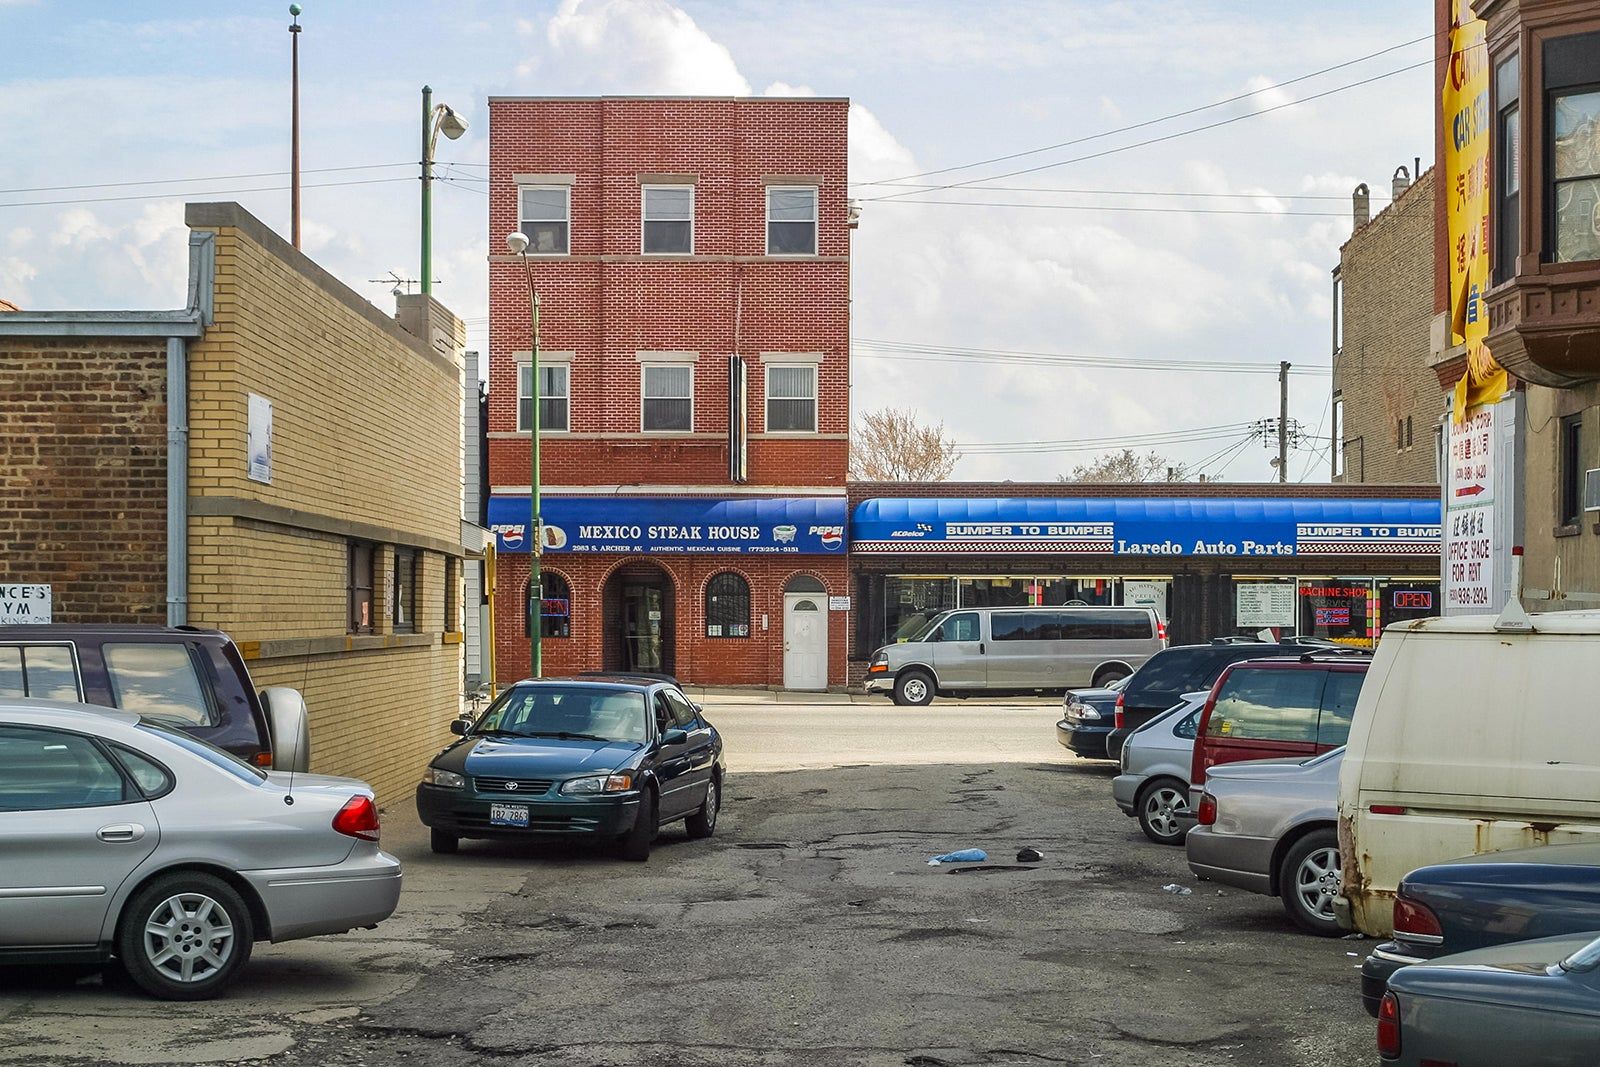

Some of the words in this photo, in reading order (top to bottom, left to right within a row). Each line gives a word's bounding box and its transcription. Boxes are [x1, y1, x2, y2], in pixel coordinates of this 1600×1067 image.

[1453, 106, 1470, 152] CAR
[490, 524, 525, 534] PEPSI
[579, 526, 641, 539] MEXICO
[648, 526, 702, 539] STEAK
[708, 526, 760, 540] HOUSE
[808, 526, 844, 535] PEPSI
[946, 526, 1012, 535] BUMPER
[1020, 526, 1040, 535] TO
[1048, 526, 1113, 535] BUMPER
[1297, 527, 1362, 536] BUMPER
[1370, 528, 1390, 536] TO
[1397, 528, 1441, 537] BUMP
[1117, 540, 1183, 554] Laredo
[1192, 540, 1237, 555] Auto
[1241, 540, 1293, 555] Parts
[1449, 541, 1468, 560] OFFICE
[1471, 539, 1489, 559] SPACE
[1452, 563, 1465, 582] FOR
[1468, 562, 1482, 581] RENT
[1300, 588, 1340, 597] MACHINE
[1343, 588, 1367, 597] SHOP
[1396, 593, 1430, 607] OPEN
